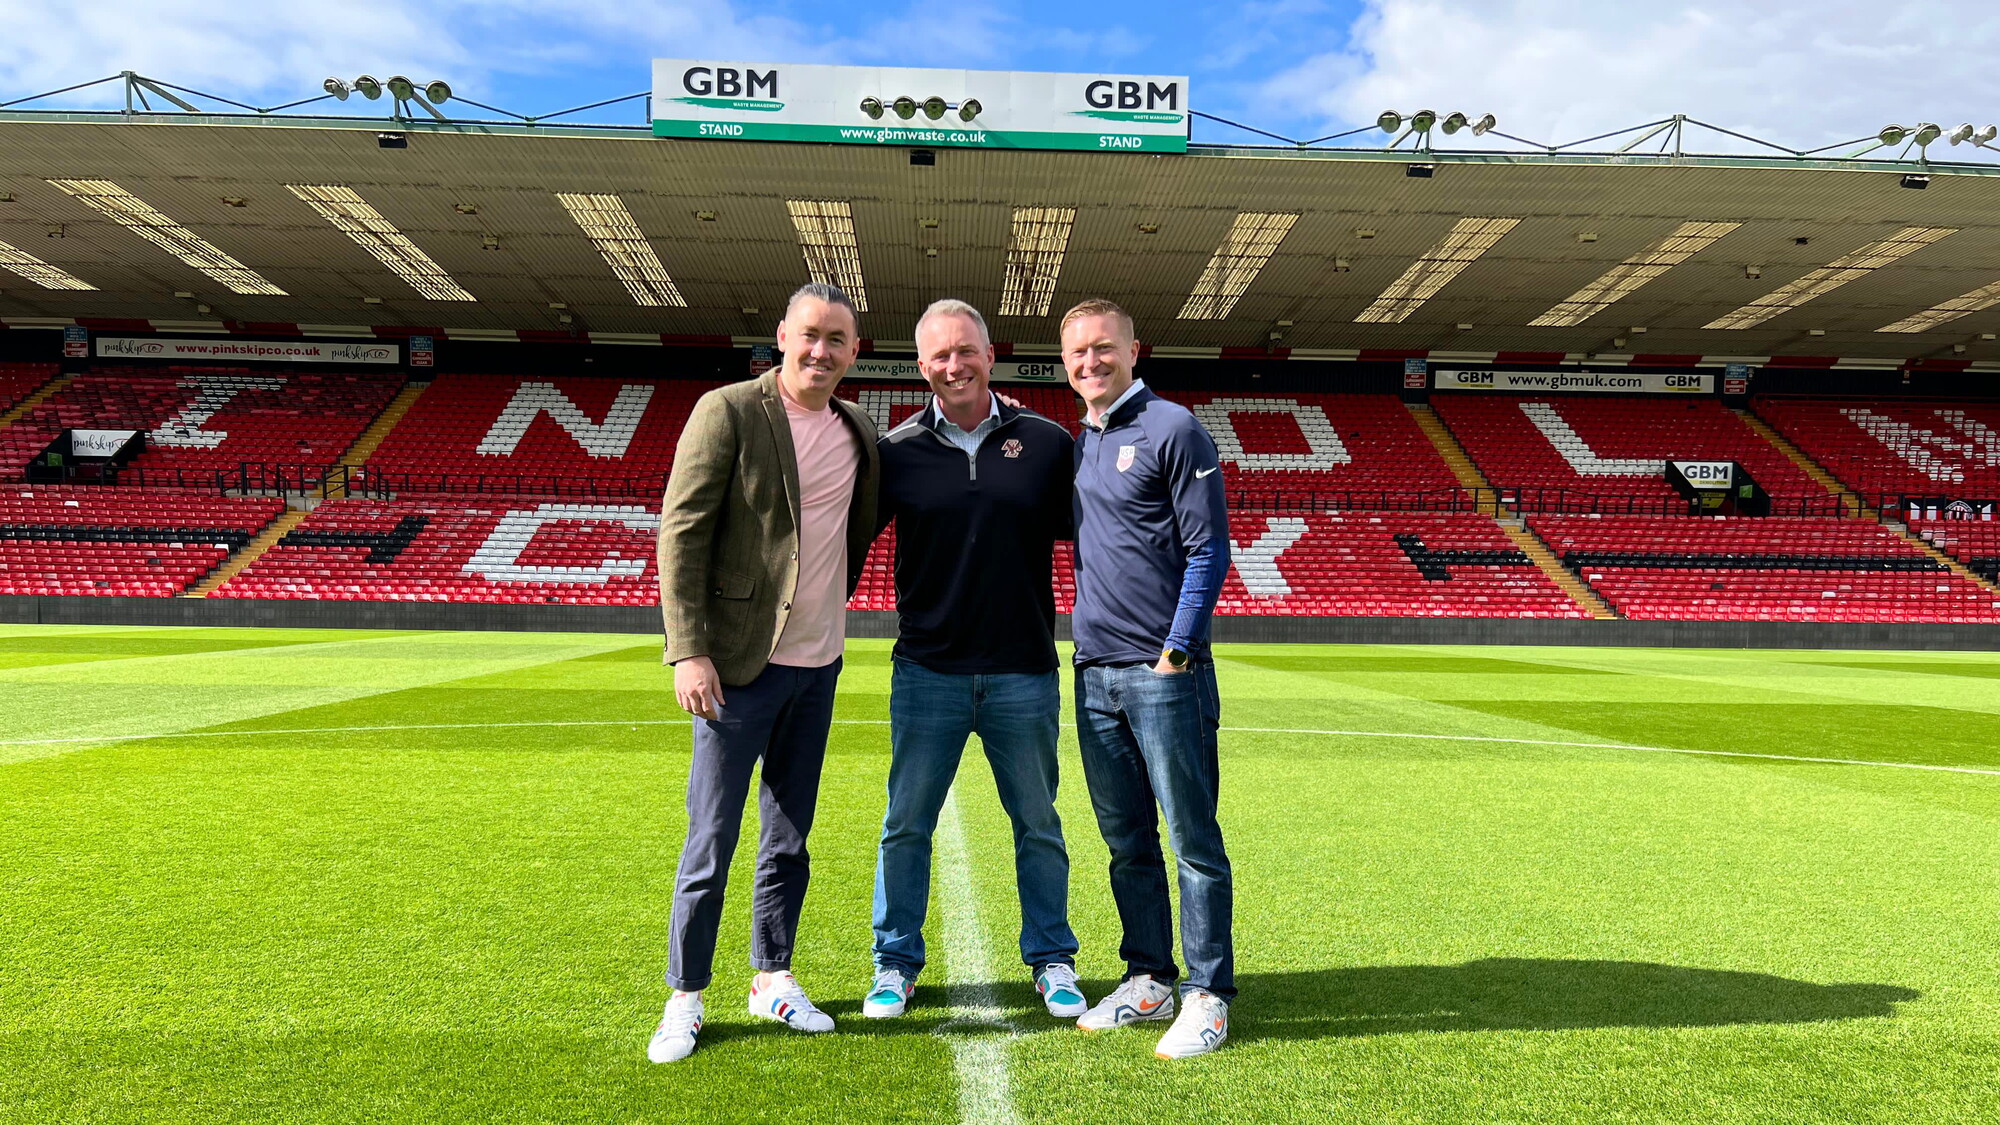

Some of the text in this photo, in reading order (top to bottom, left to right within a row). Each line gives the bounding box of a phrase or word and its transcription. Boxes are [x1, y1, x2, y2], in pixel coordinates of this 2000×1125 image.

[683, 67, 778, 98] GBM
[1085, 80, 1177, 110] GBM
[699, 123, 743, 136] STAND
[840, 128, 986, 142] www.gbmwaste.co.uk
[1099, 136, 1142, 148] STAND
[175, 344, 321, 357] www.pinkskipco.co.uk
[1017, 364, 1054, 376] GBM
[1457, 372, 1494, 383] GBM
[1508, 374, 1642, 389] www.gbmuk.com
[1664, 375, 1701, 387] GBM
[1121, 447, 1134, 457] USA
[1684, 465, 1729, 479] GBM
